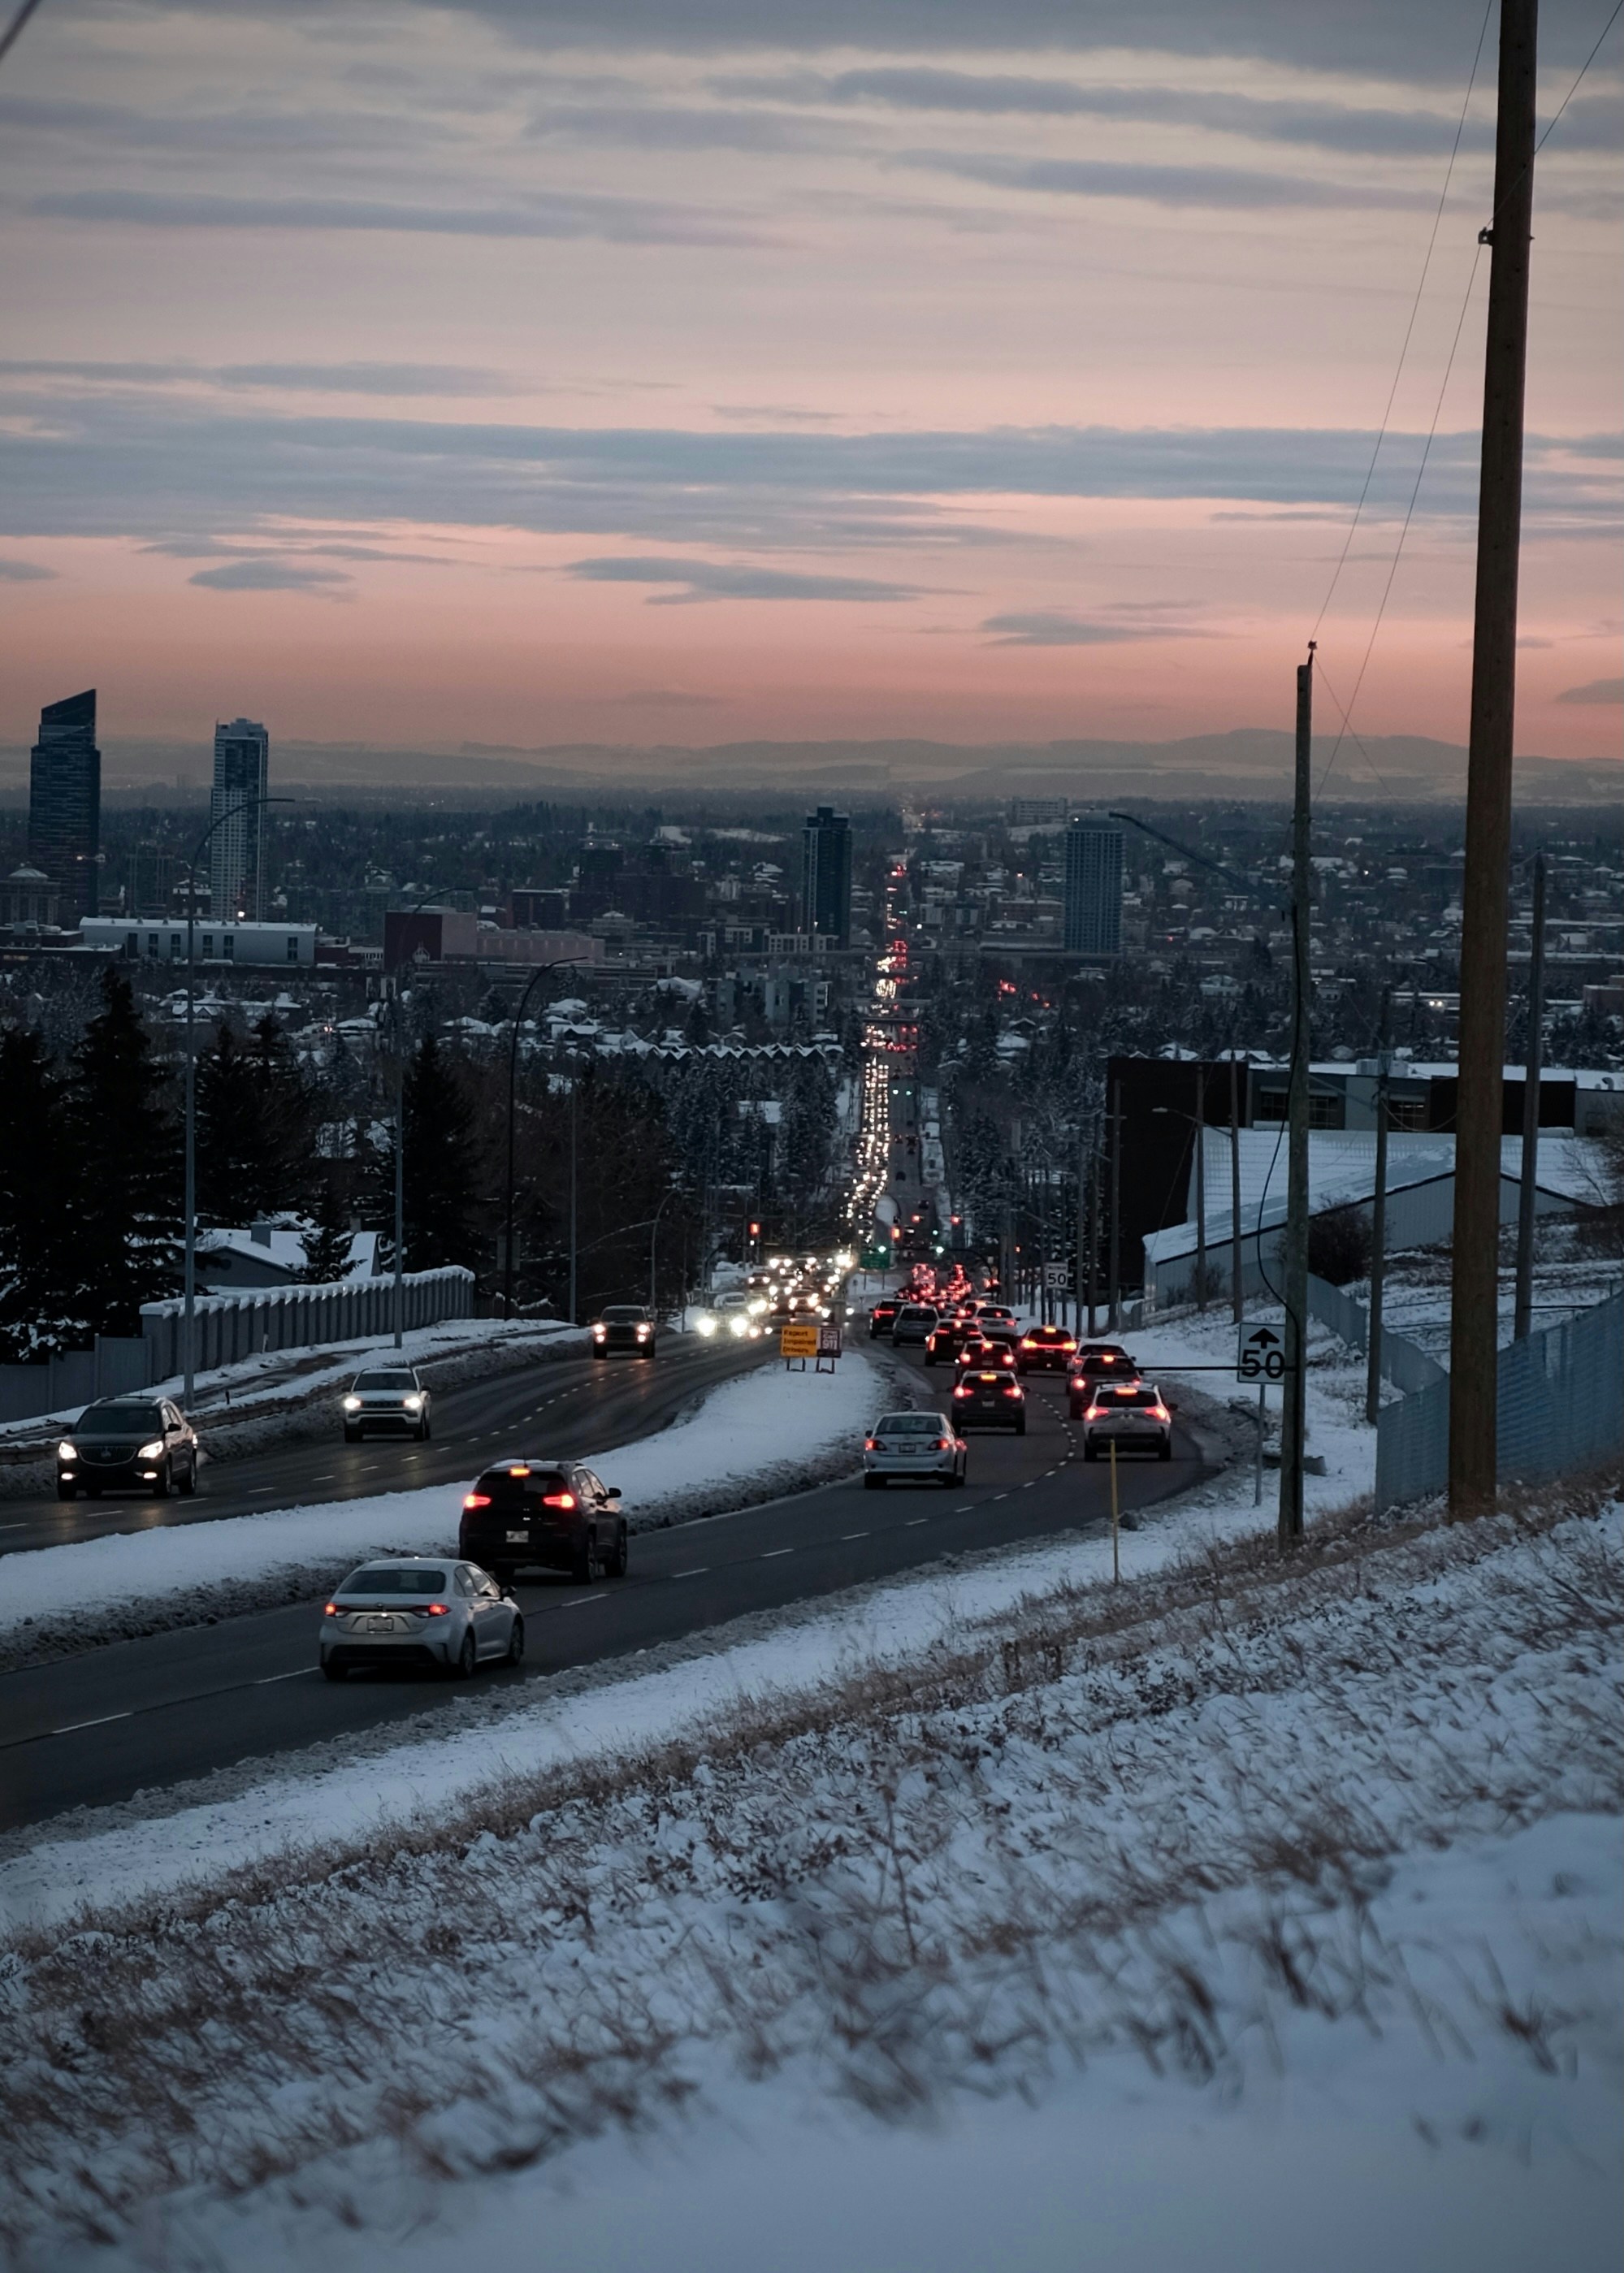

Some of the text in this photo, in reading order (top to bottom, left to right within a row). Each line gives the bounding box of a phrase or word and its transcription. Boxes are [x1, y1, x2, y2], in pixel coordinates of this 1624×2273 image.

[1048, 1273, 1066, 1285] 50
[823, 1340, 838, 1350] 911
[1241, 1349, 1284, 1379] 50
